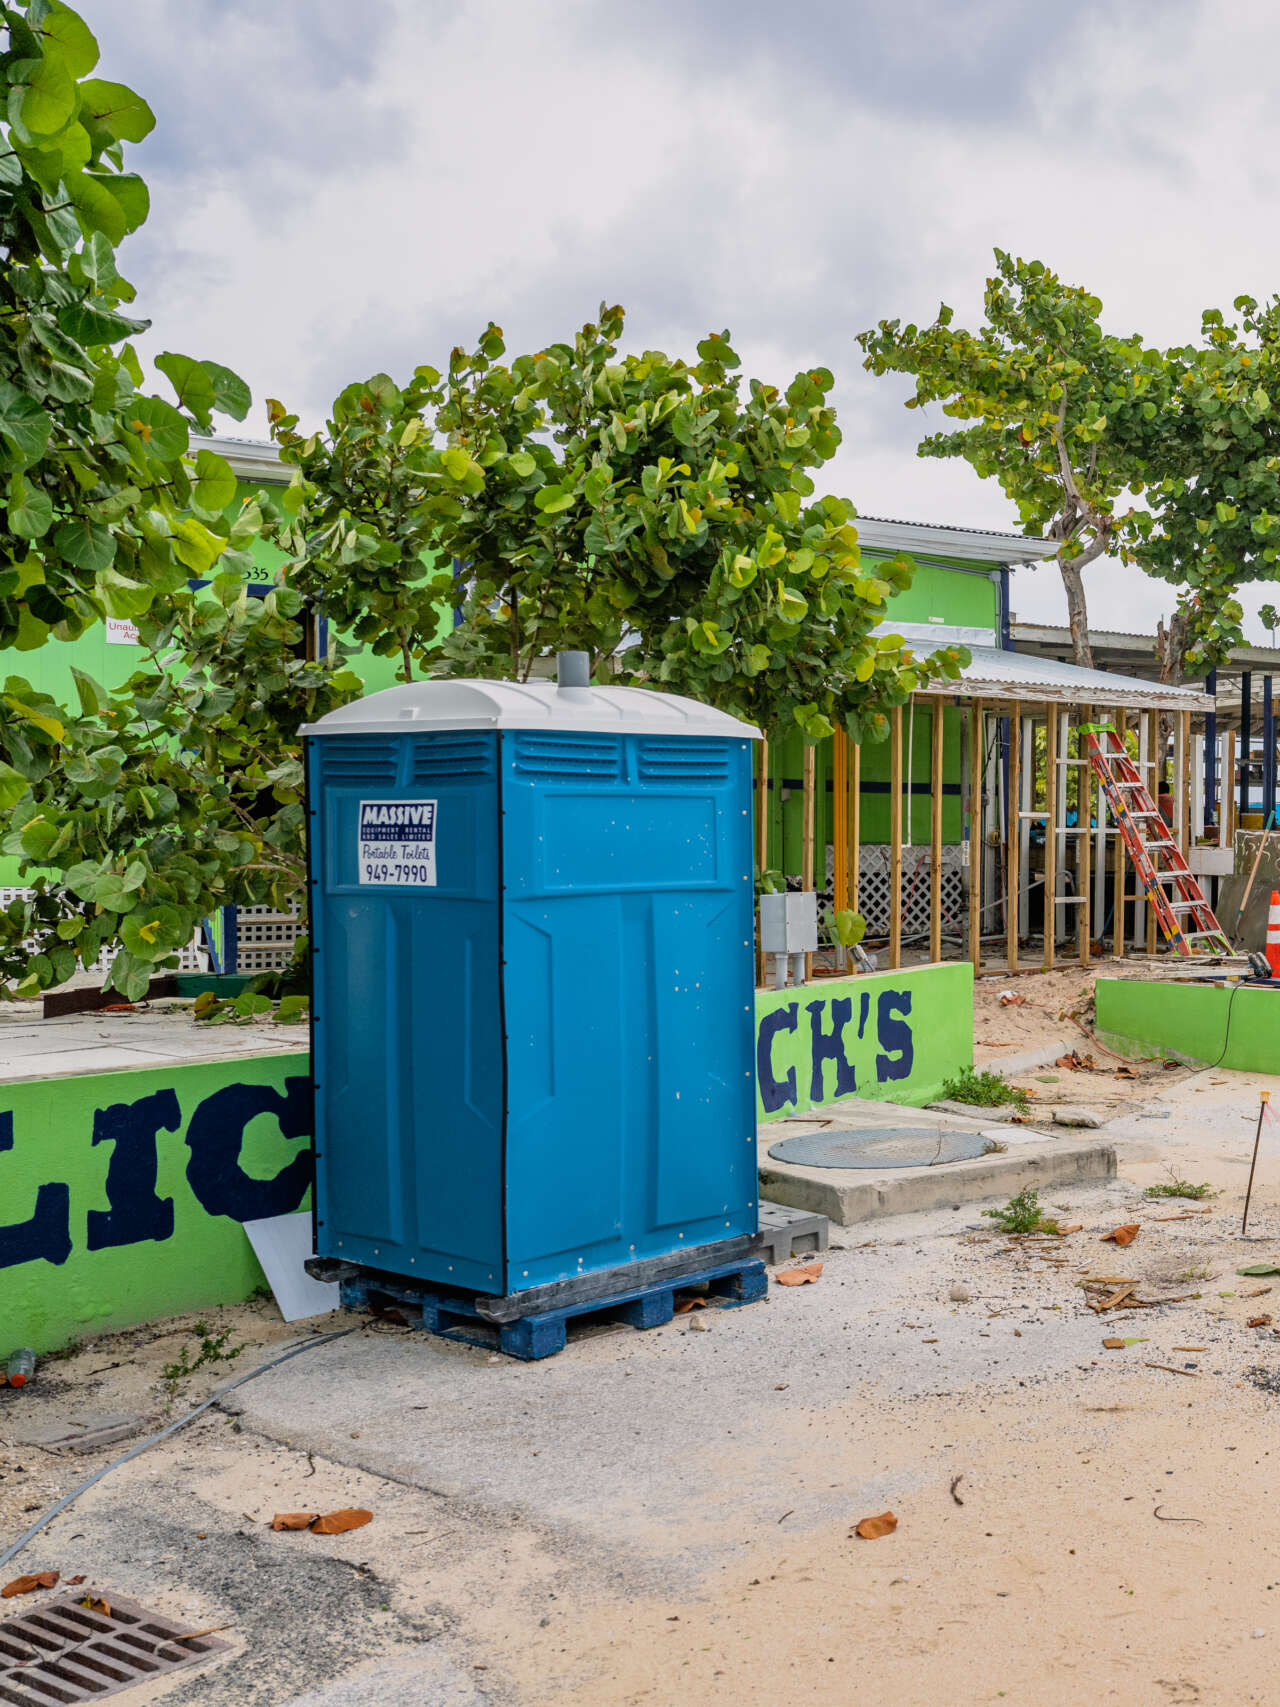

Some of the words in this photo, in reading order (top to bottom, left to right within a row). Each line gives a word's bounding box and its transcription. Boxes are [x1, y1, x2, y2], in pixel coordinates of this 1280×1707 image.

[362, 805, 433, 826] MASSIVE
[362, 844, 398, 860] Portable
[400, 844, 430, 861] Toilets
[366, 863, 428, 883] 949-7990
